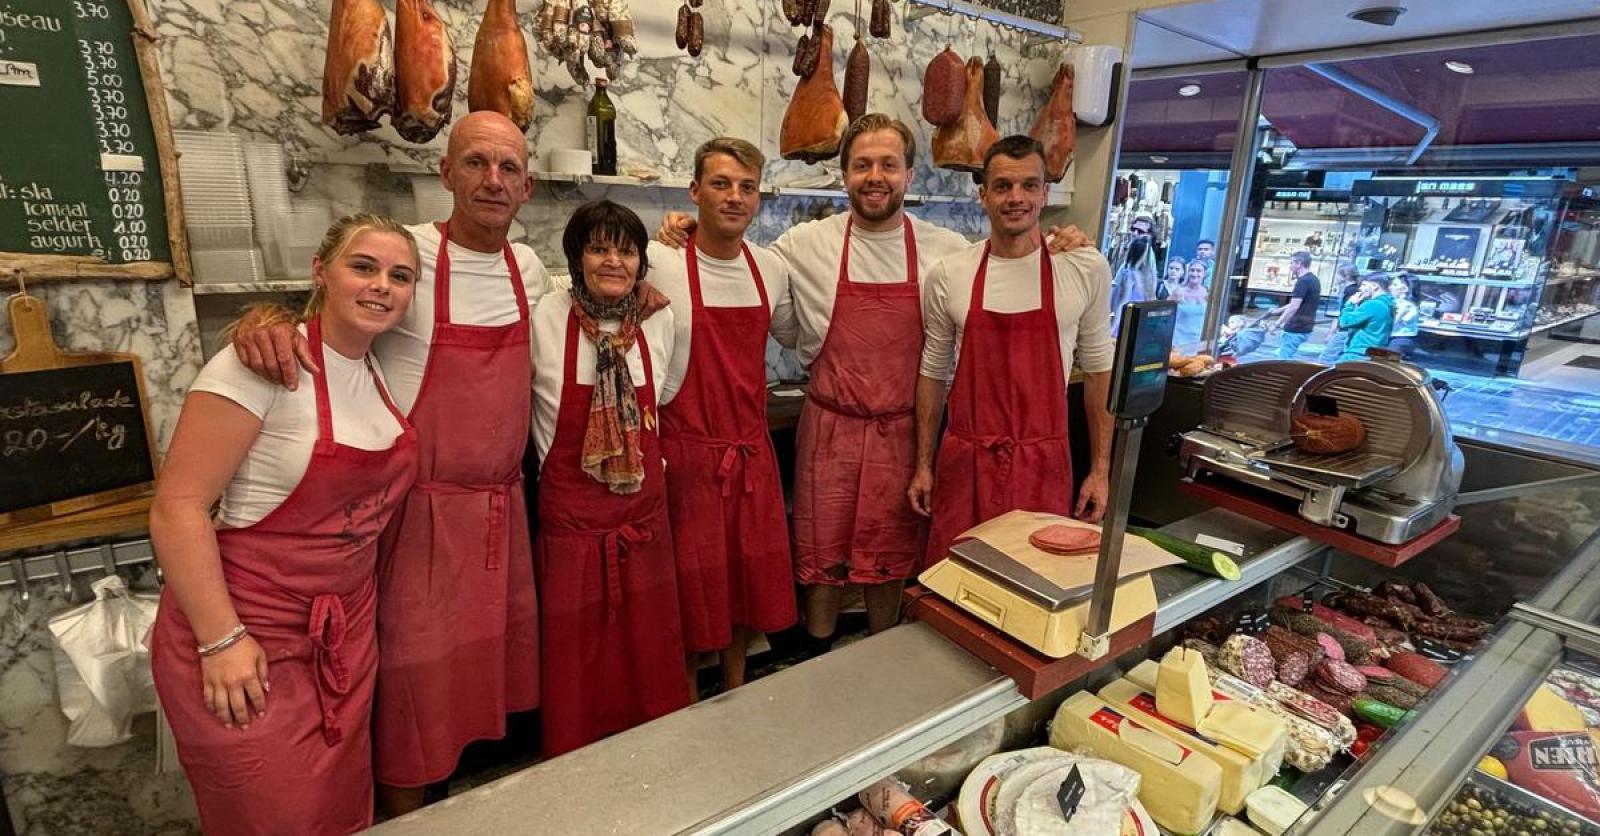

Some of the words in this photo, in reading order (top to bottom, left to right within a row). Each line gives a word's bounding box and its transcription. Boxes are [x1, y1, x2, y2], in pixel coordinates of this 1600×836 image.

[74, 1, 109, 18] 3.70
[80, 40, 114, 54] 3.70
[84, 56, 117, 70] 3.70
[88, 71, 122, 86] 5.00
[88, 88, 124, 103] 3.70
[92, 105, 127, 121] 3.70
[96, 121, 130, 137] 3.70
[100, 139, 134, 154] 3.70
[104, 172, 140, 186] 4.20
[21, 184, 52, 200] sla
[108, 189, 140, 202] 0.20
[1415, 181, 1437, 193] jan
[112, 205, 144, 218] 0.20
[28, 218, 91, 233] selder
[119, 237, 148, 249] 0.20
[122, 249, 151, 261] 0.20
